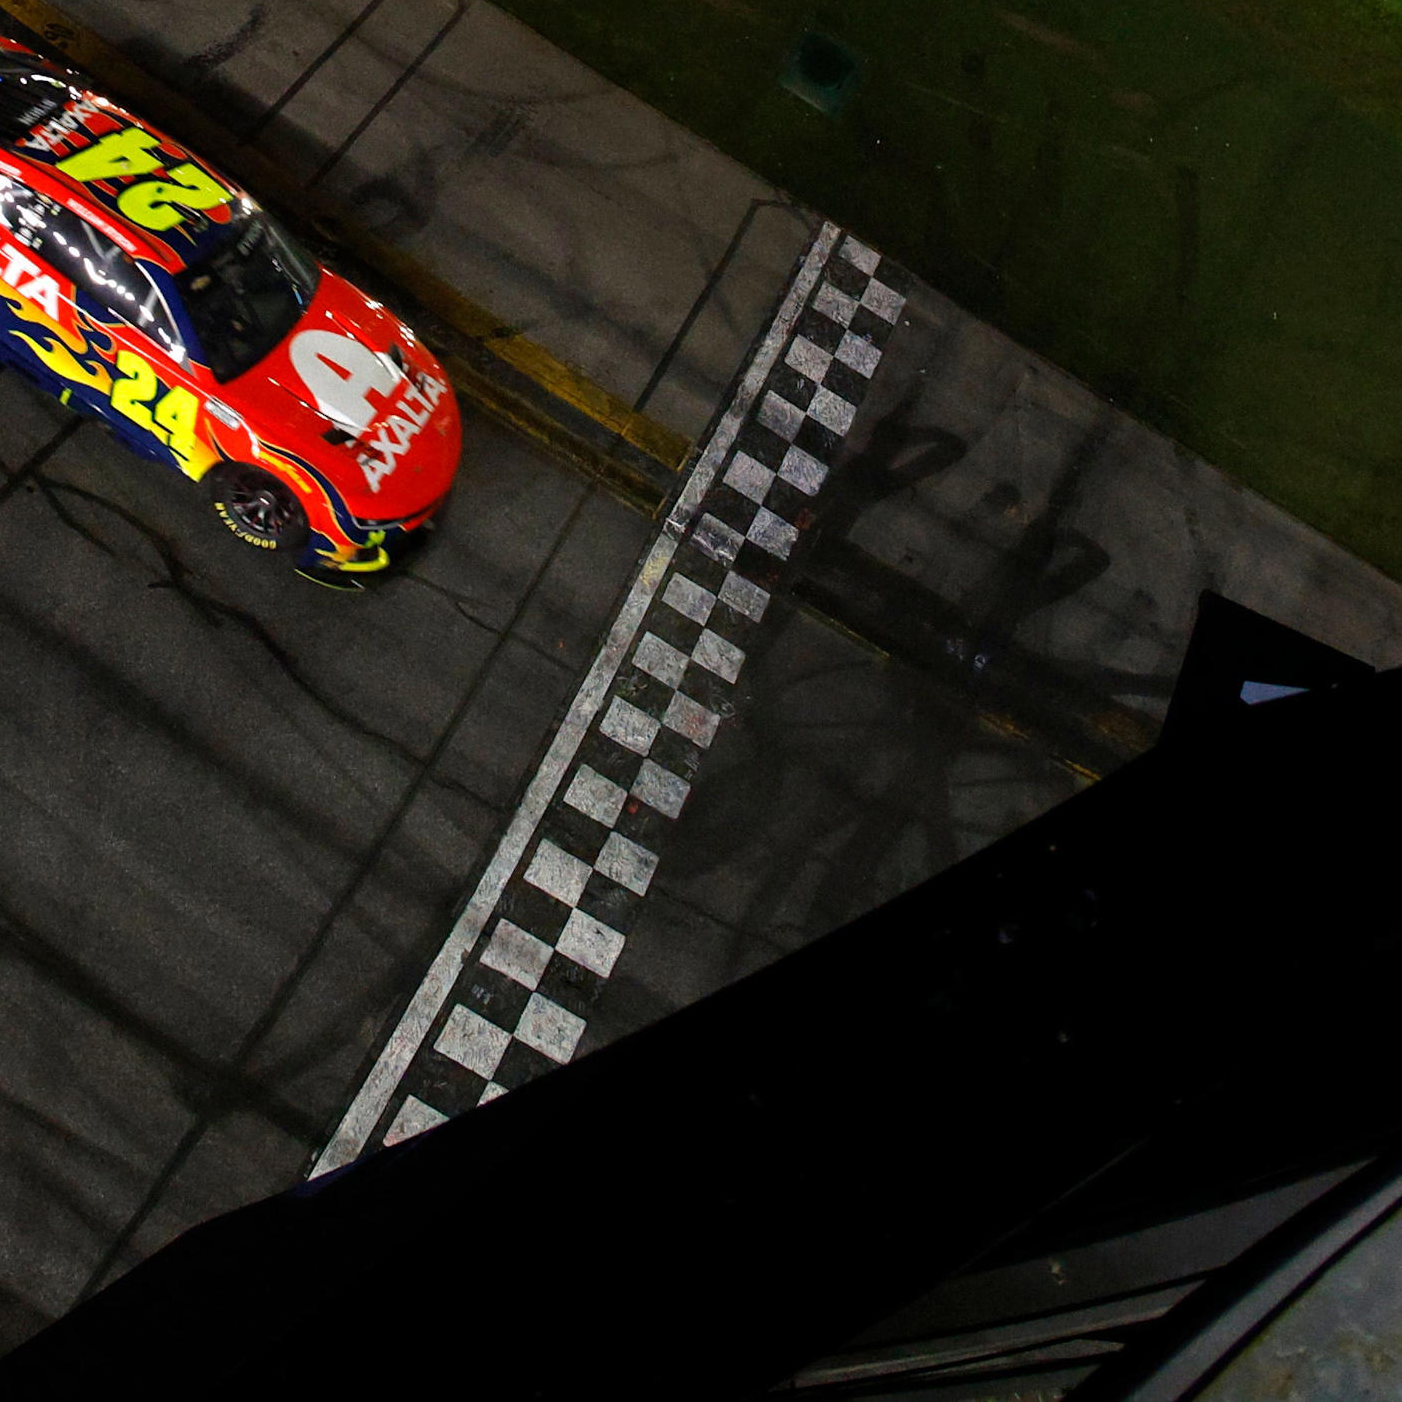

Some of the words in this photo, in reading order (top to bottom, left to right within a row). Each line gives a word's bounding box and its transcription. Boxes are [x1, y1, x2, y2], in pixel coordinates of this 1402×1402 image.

[56, 126, 232, 232] 24
[109, 350, 201, 464] 24
[354, 372, 448, 494] AXALTA
